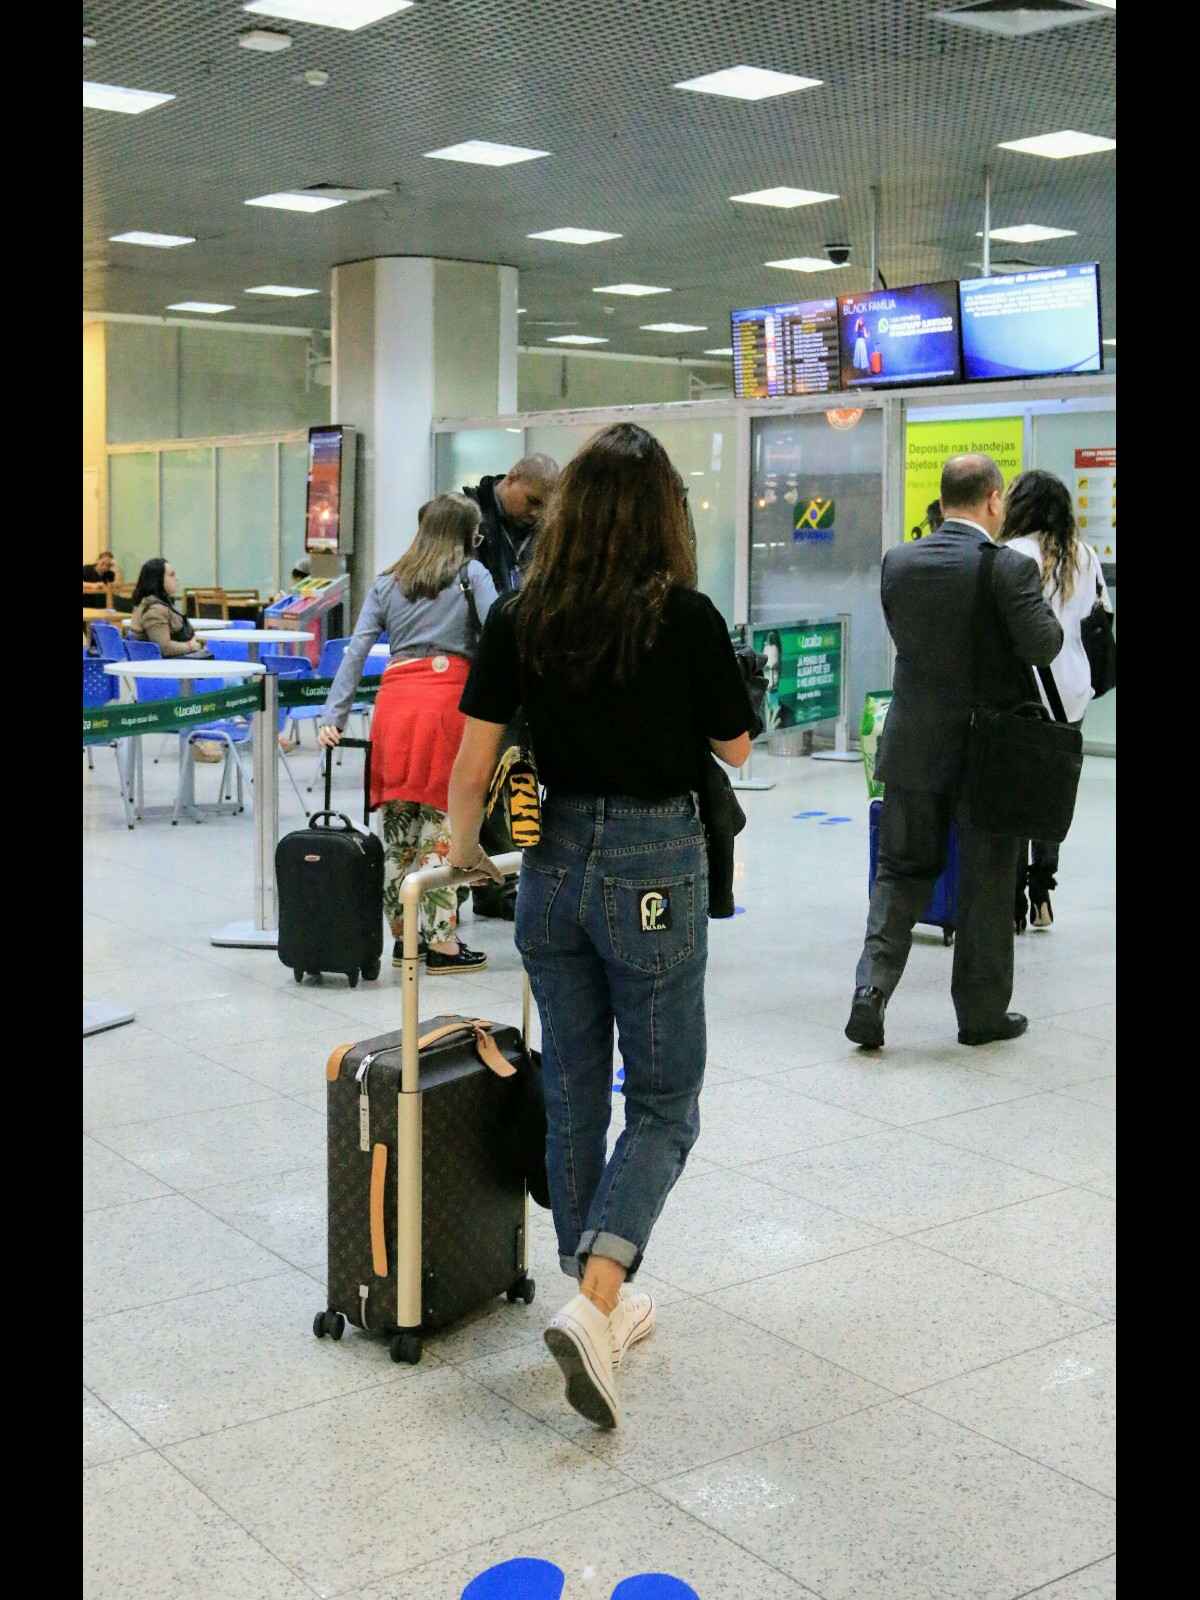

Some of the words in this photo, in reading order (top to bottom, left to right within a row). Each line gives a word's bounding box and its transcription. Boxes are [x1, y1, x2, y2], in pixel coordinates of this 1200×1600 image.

[843, 303, 867, 315] BLACK
[909, 443, 949, 455] Deposite
[972, 442, 1015, 453] bandejas
[905, 460, 938, 472] objetos
[802, 634, 822, 648] Localiza
[179, 704, 202, 717] Localiza
